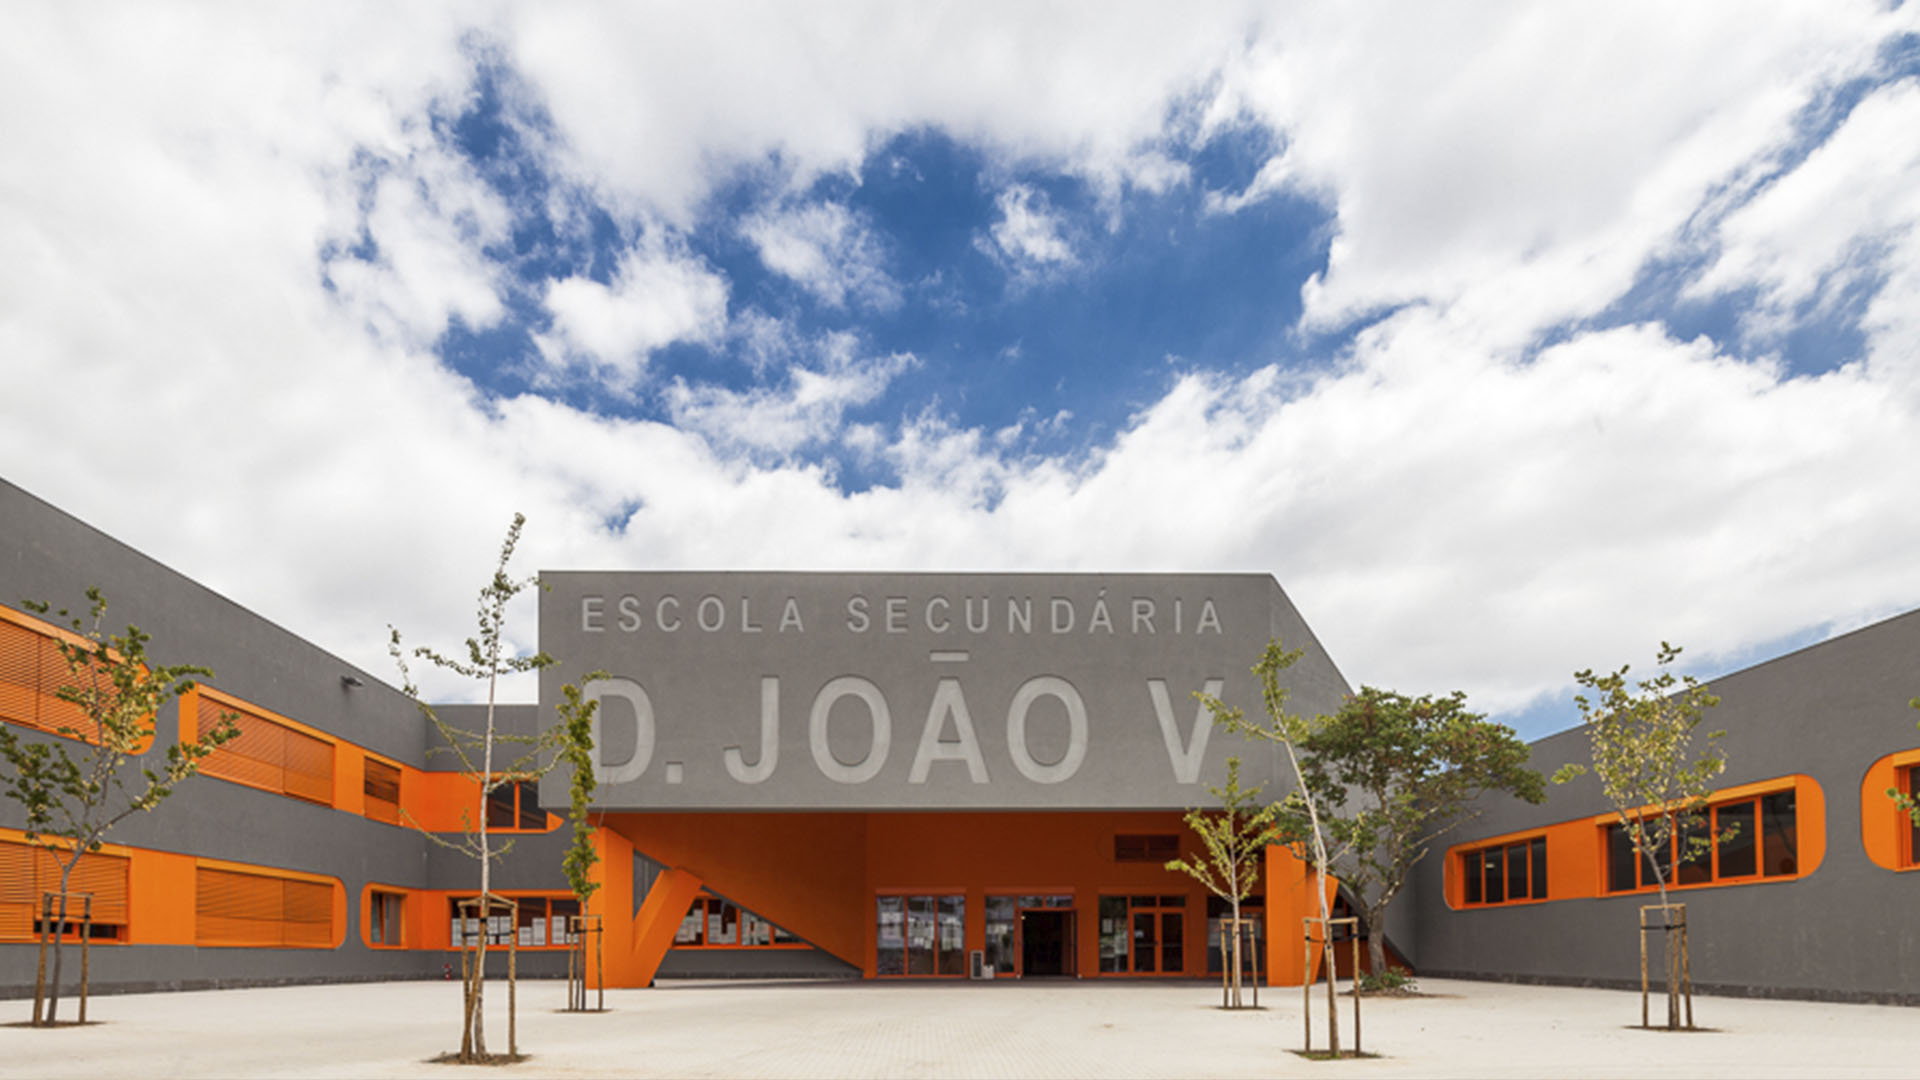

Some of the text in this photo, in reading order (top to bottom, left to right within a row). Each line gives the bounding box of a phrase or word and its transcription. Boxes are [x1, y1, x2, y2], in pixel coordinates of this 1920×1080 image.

[581, 589, 1224, 634] ESCOLA SECUNDÁRIA
[582, 676, 683, 785] D.
[1147, 677, 1225, 785] V
